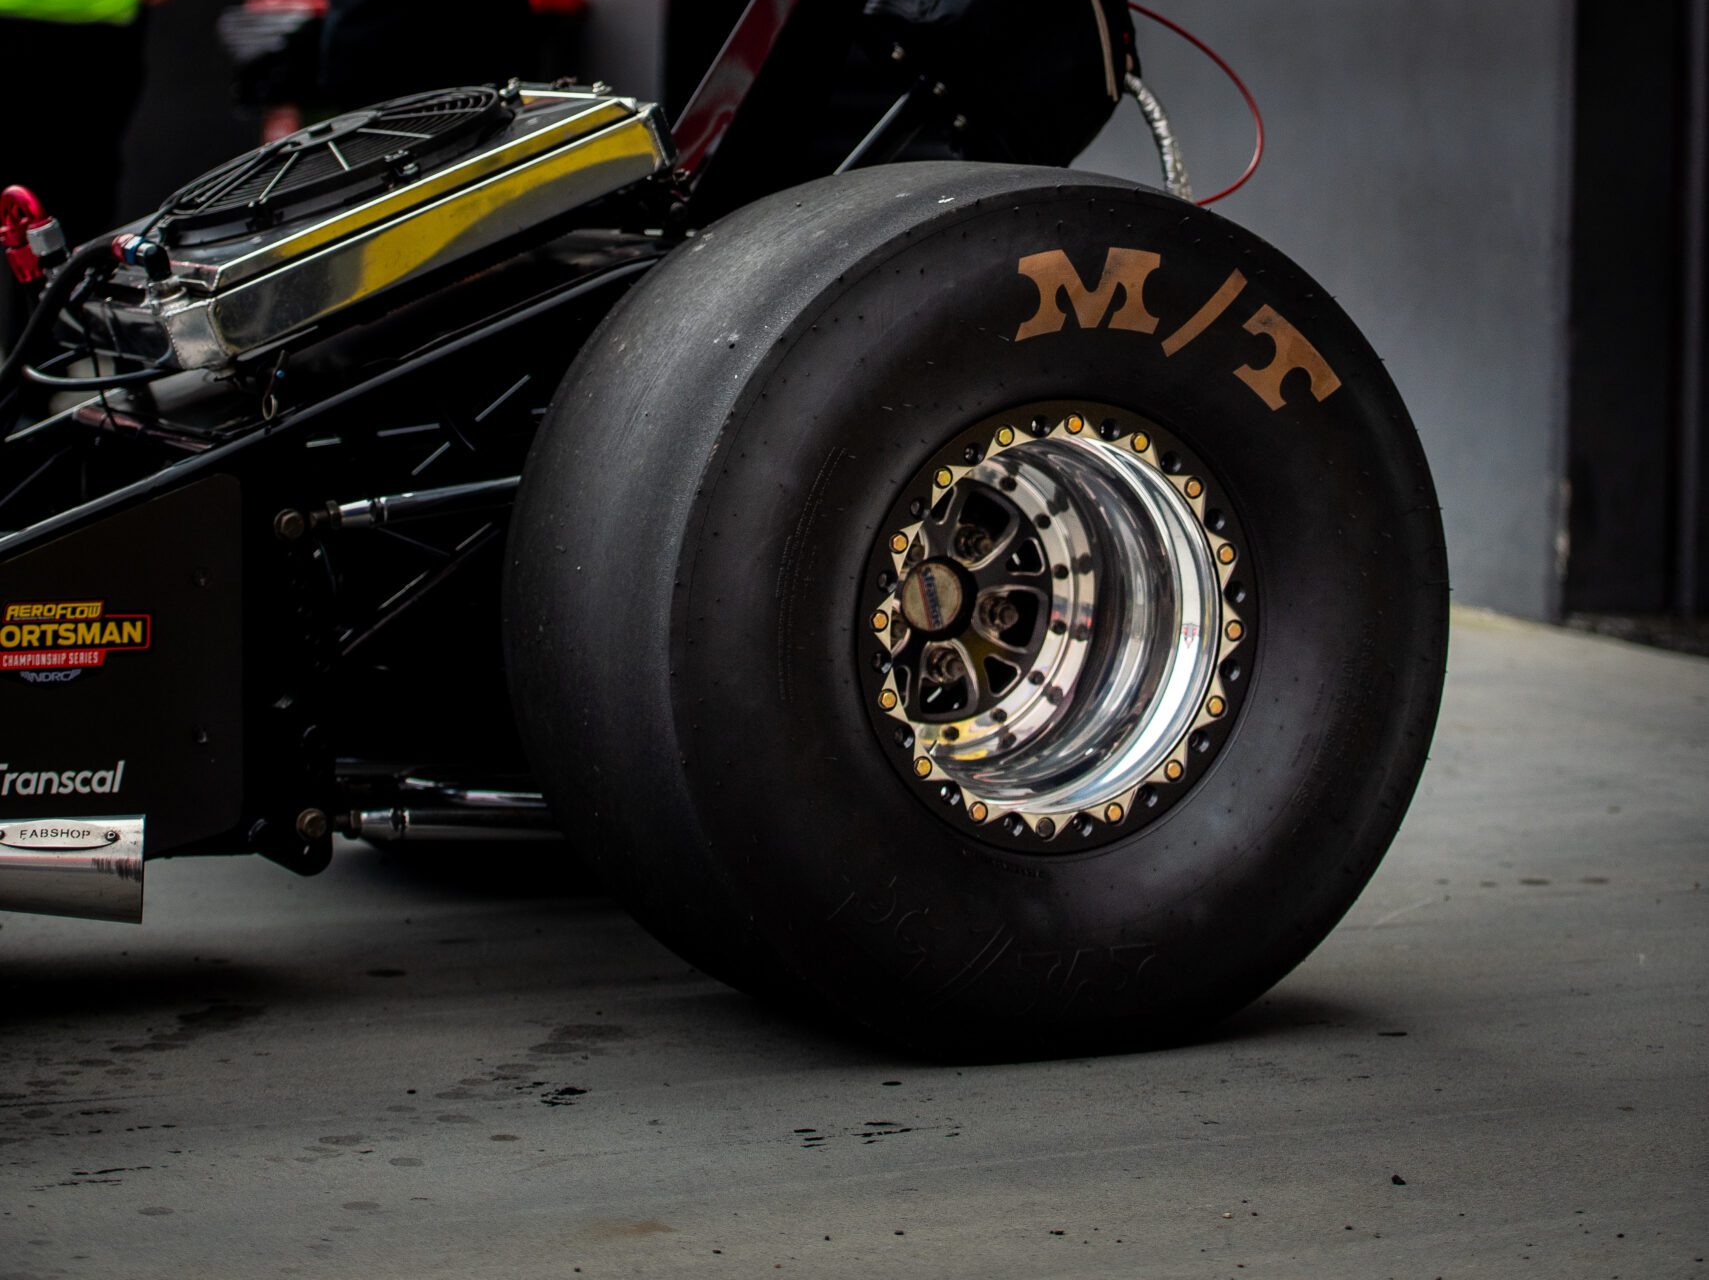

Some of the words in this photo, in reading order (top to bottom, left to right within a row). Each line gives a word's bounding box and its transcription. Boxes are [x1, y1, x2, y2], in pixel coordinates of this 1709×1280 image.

[1015, 247, 1342, 411] M/T
[6, 601, 103, 621] AEROFLOW
[2, 652, 67, 667] CHAMPIONSHIP
[68, 651, 99, 664] SERIES
[19, 828, 91, 840] FABSHOP
